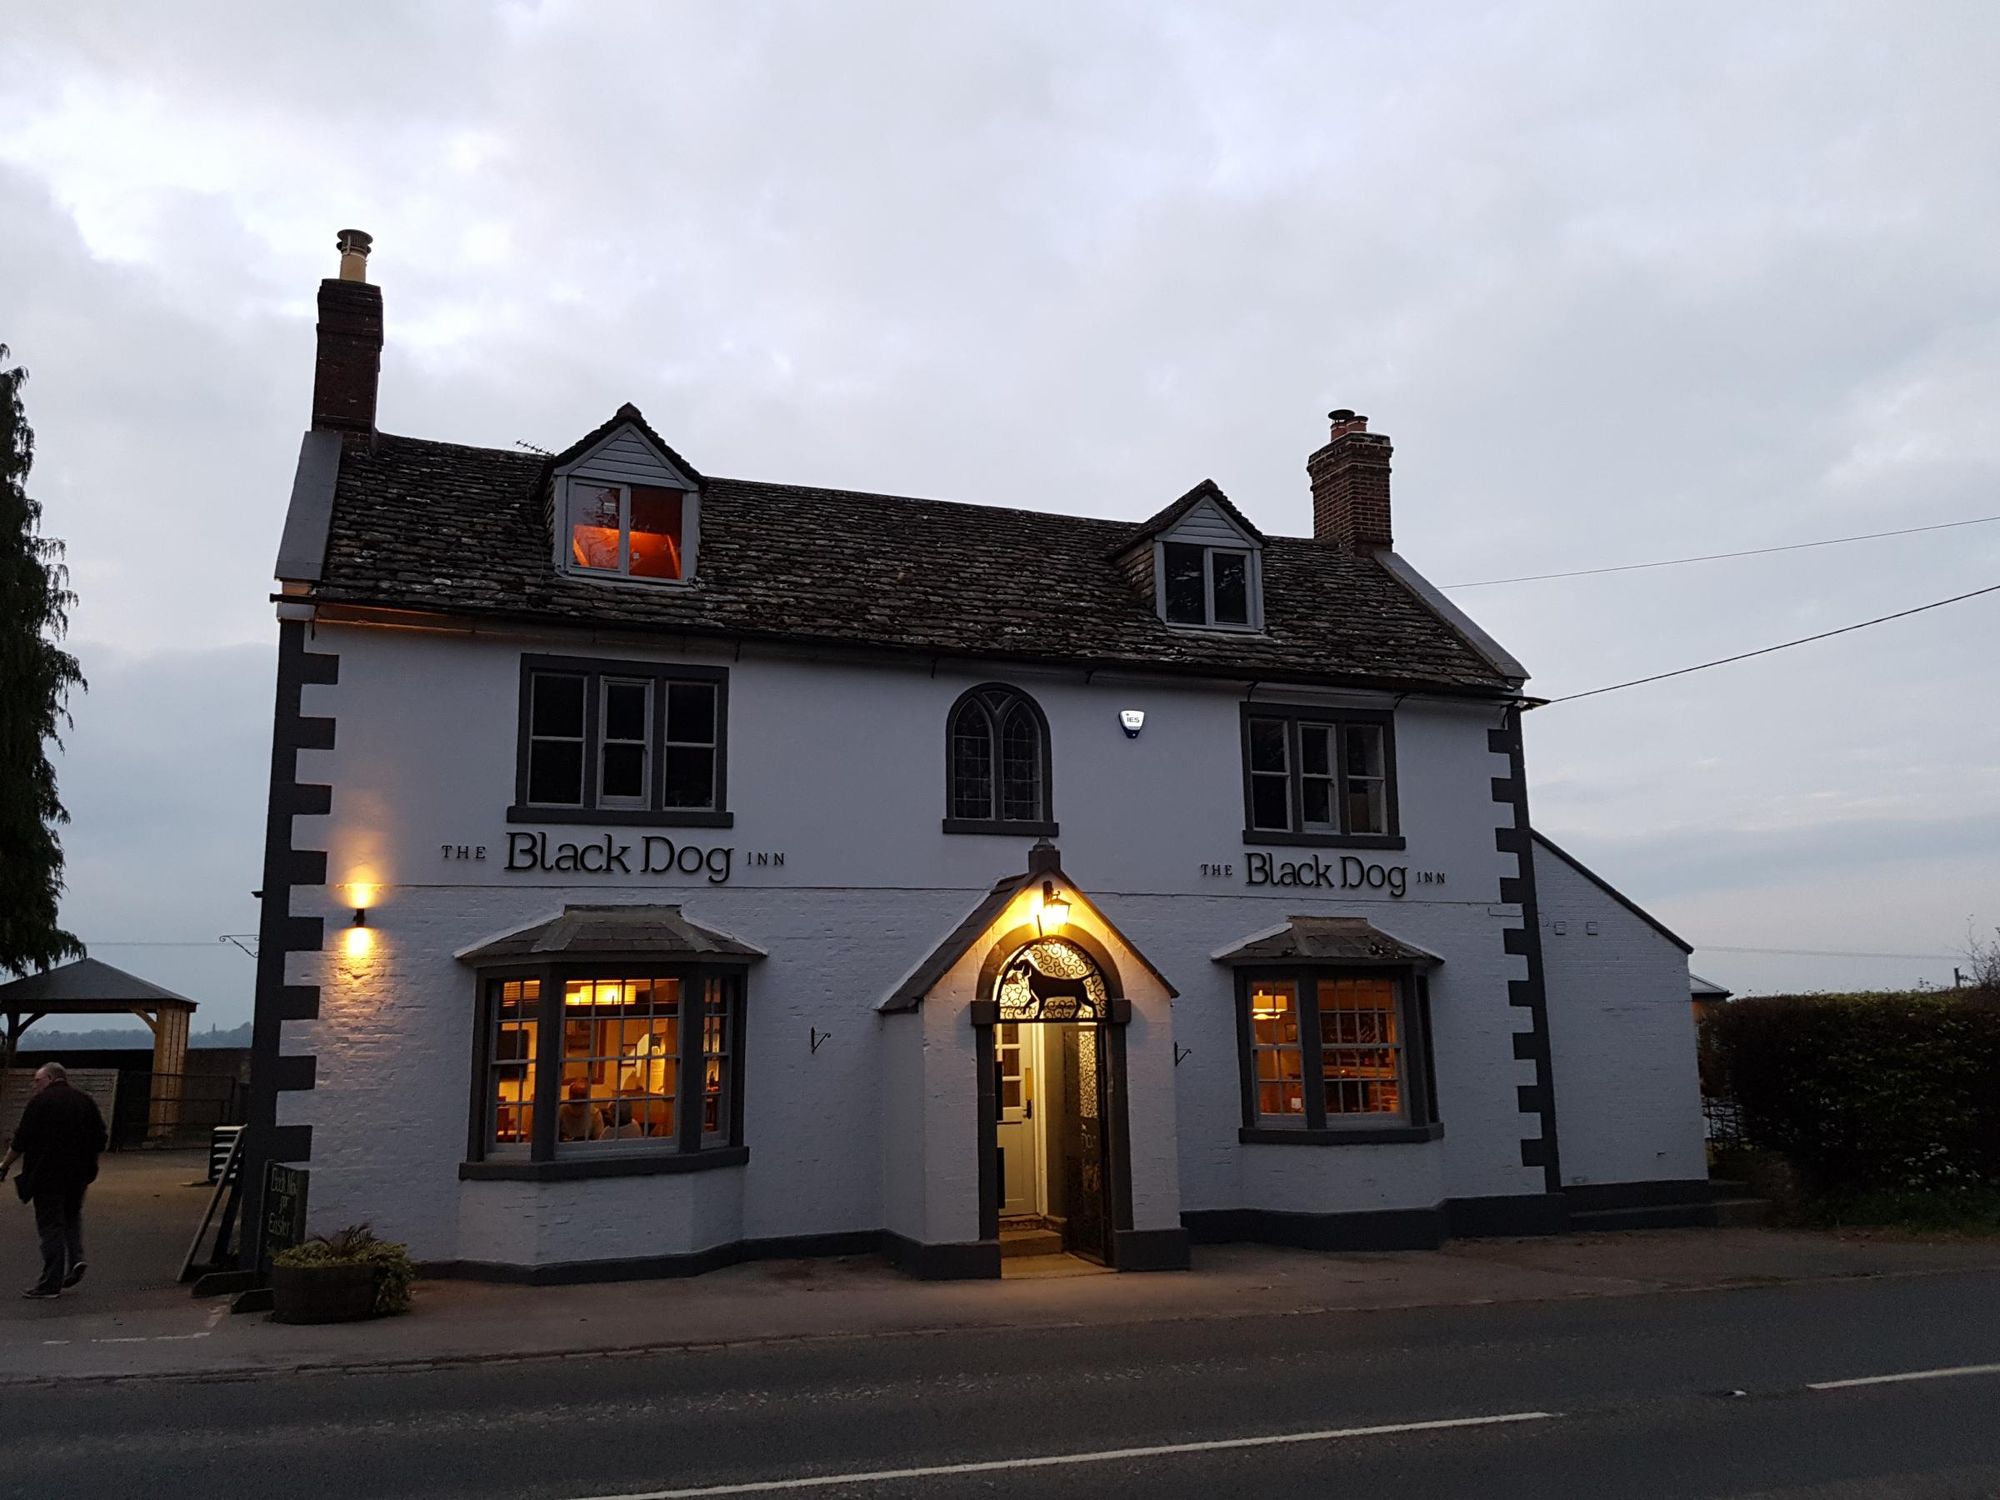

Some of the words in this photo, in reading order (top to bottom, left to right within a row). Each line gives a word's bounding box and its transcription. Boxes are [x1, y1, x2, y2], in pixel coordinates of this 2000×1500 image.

[441, 845, 486, 859] THE
[504, 832, 631, 873] Black
[641, 836, 735, 884] Dog
[748, 852, 785, 866] INN
[1201, 864, 1232, 876] THE
[1245, 853, 1335, 888] Black
[1341, 856, 1408, 897] Dog
[1416, 872, 1446, 884] INN
